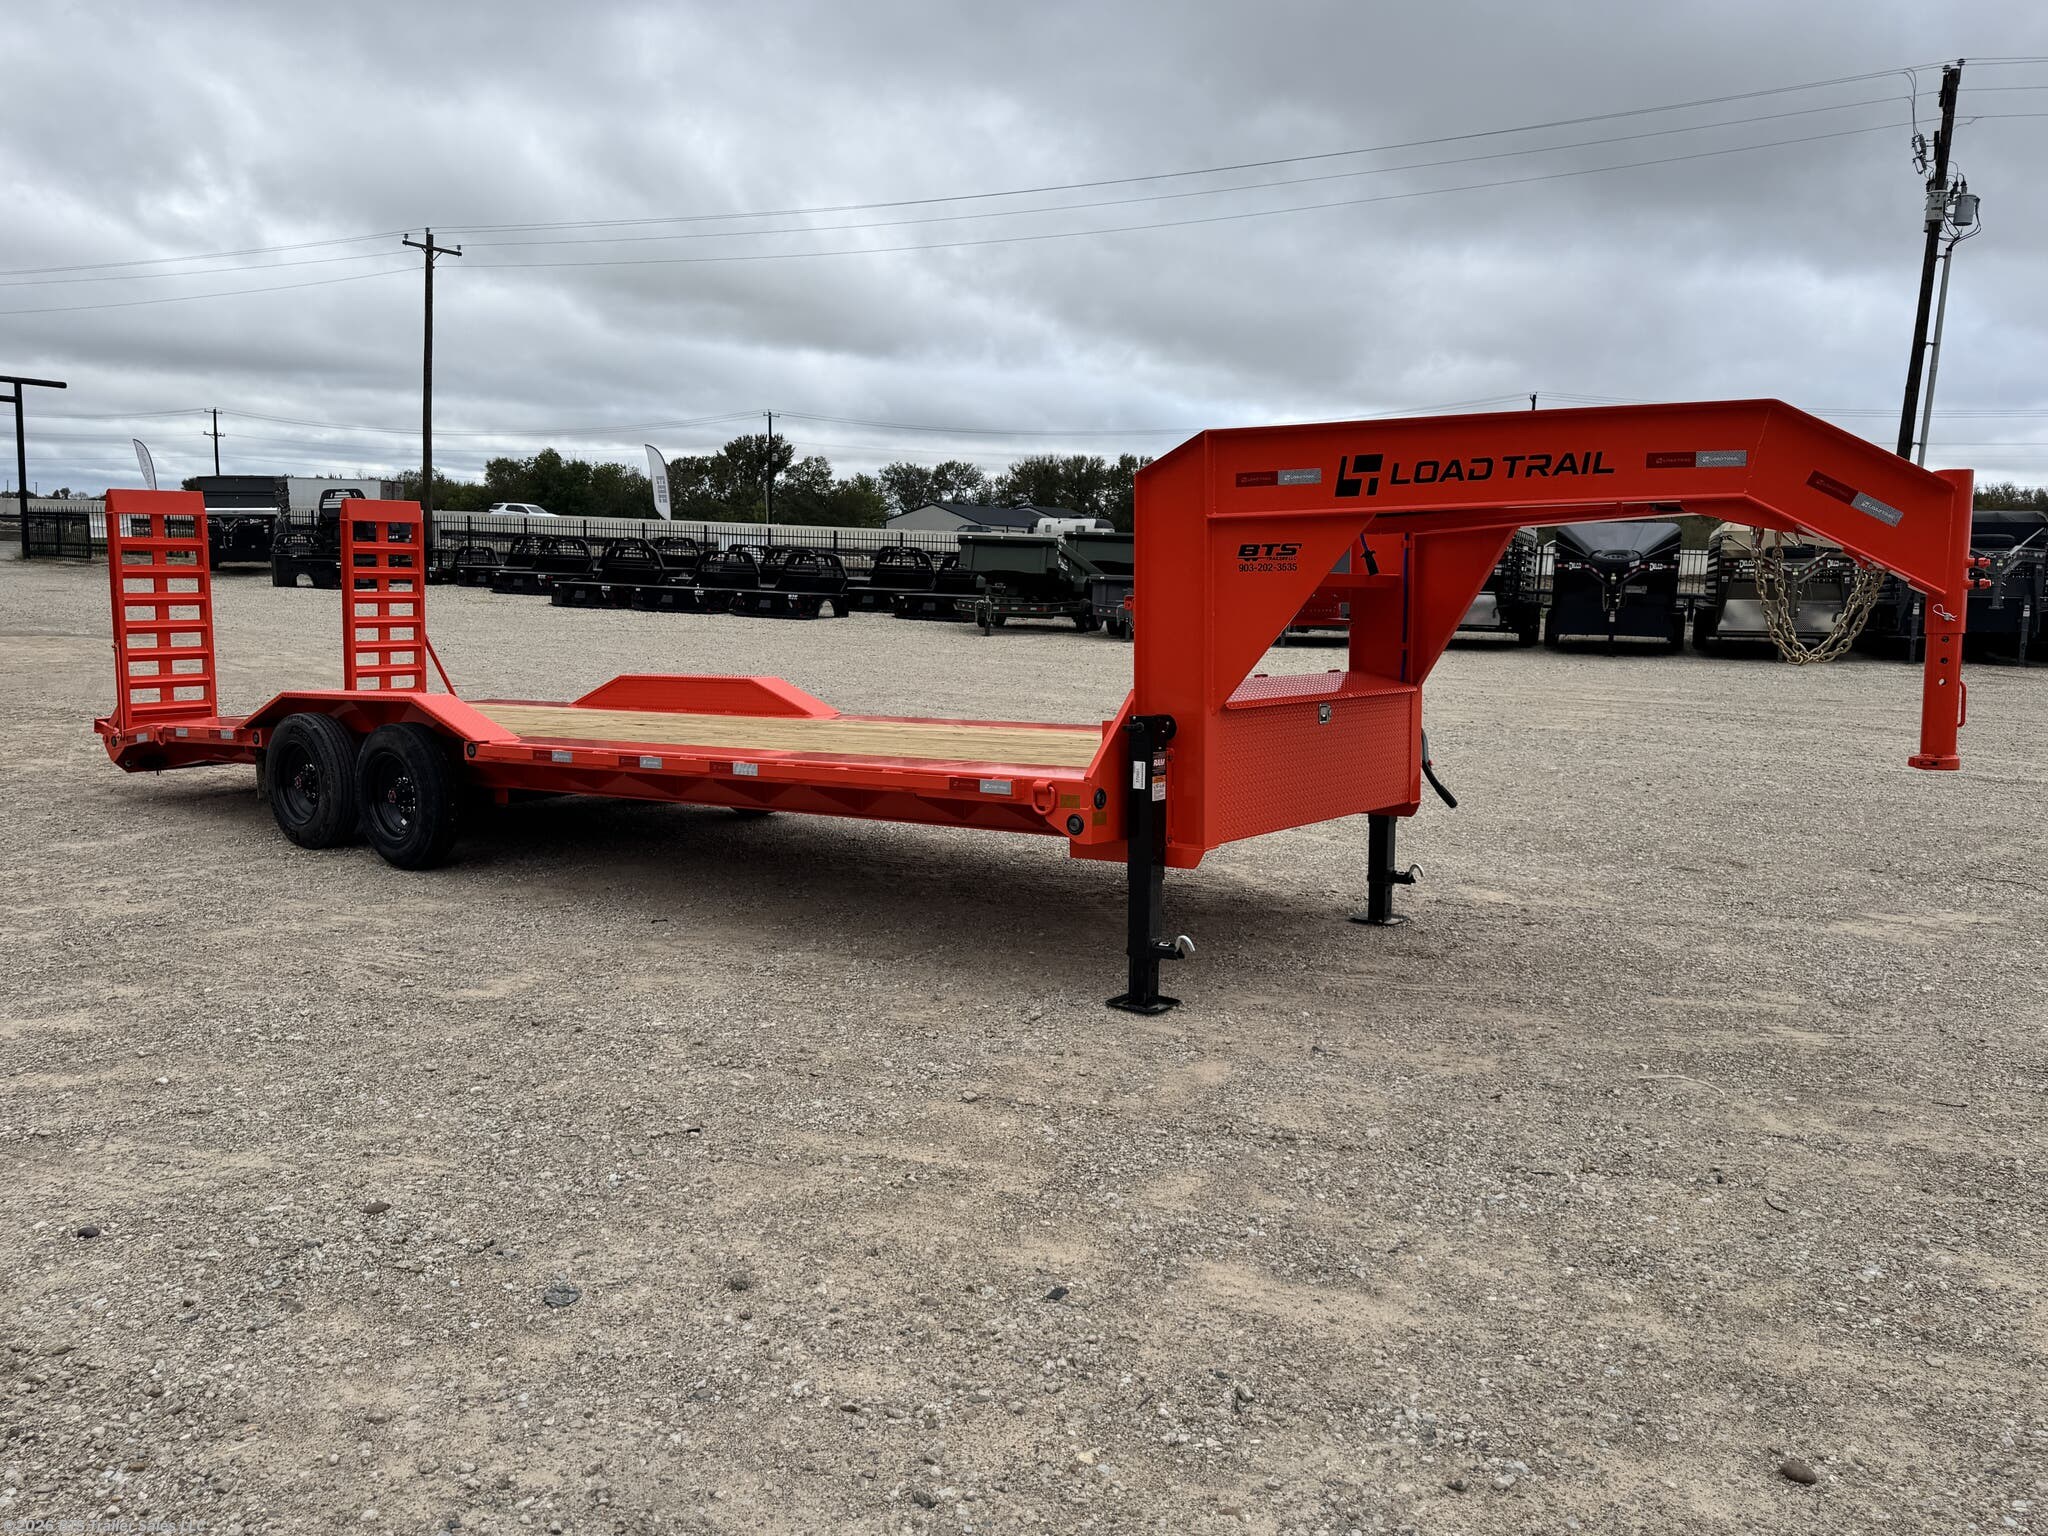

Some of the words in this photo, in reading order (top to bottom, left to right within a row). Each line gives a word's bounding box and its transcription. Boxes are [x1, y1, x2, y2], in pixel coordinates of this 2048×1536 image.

[1390, 456, 1493, 485] LOAD
[1502, 451, 1615, 479] TRAIL
[1238, 543, 1303, 557] BTS
[1239, 562, 1298, 572] 903-202-3535
